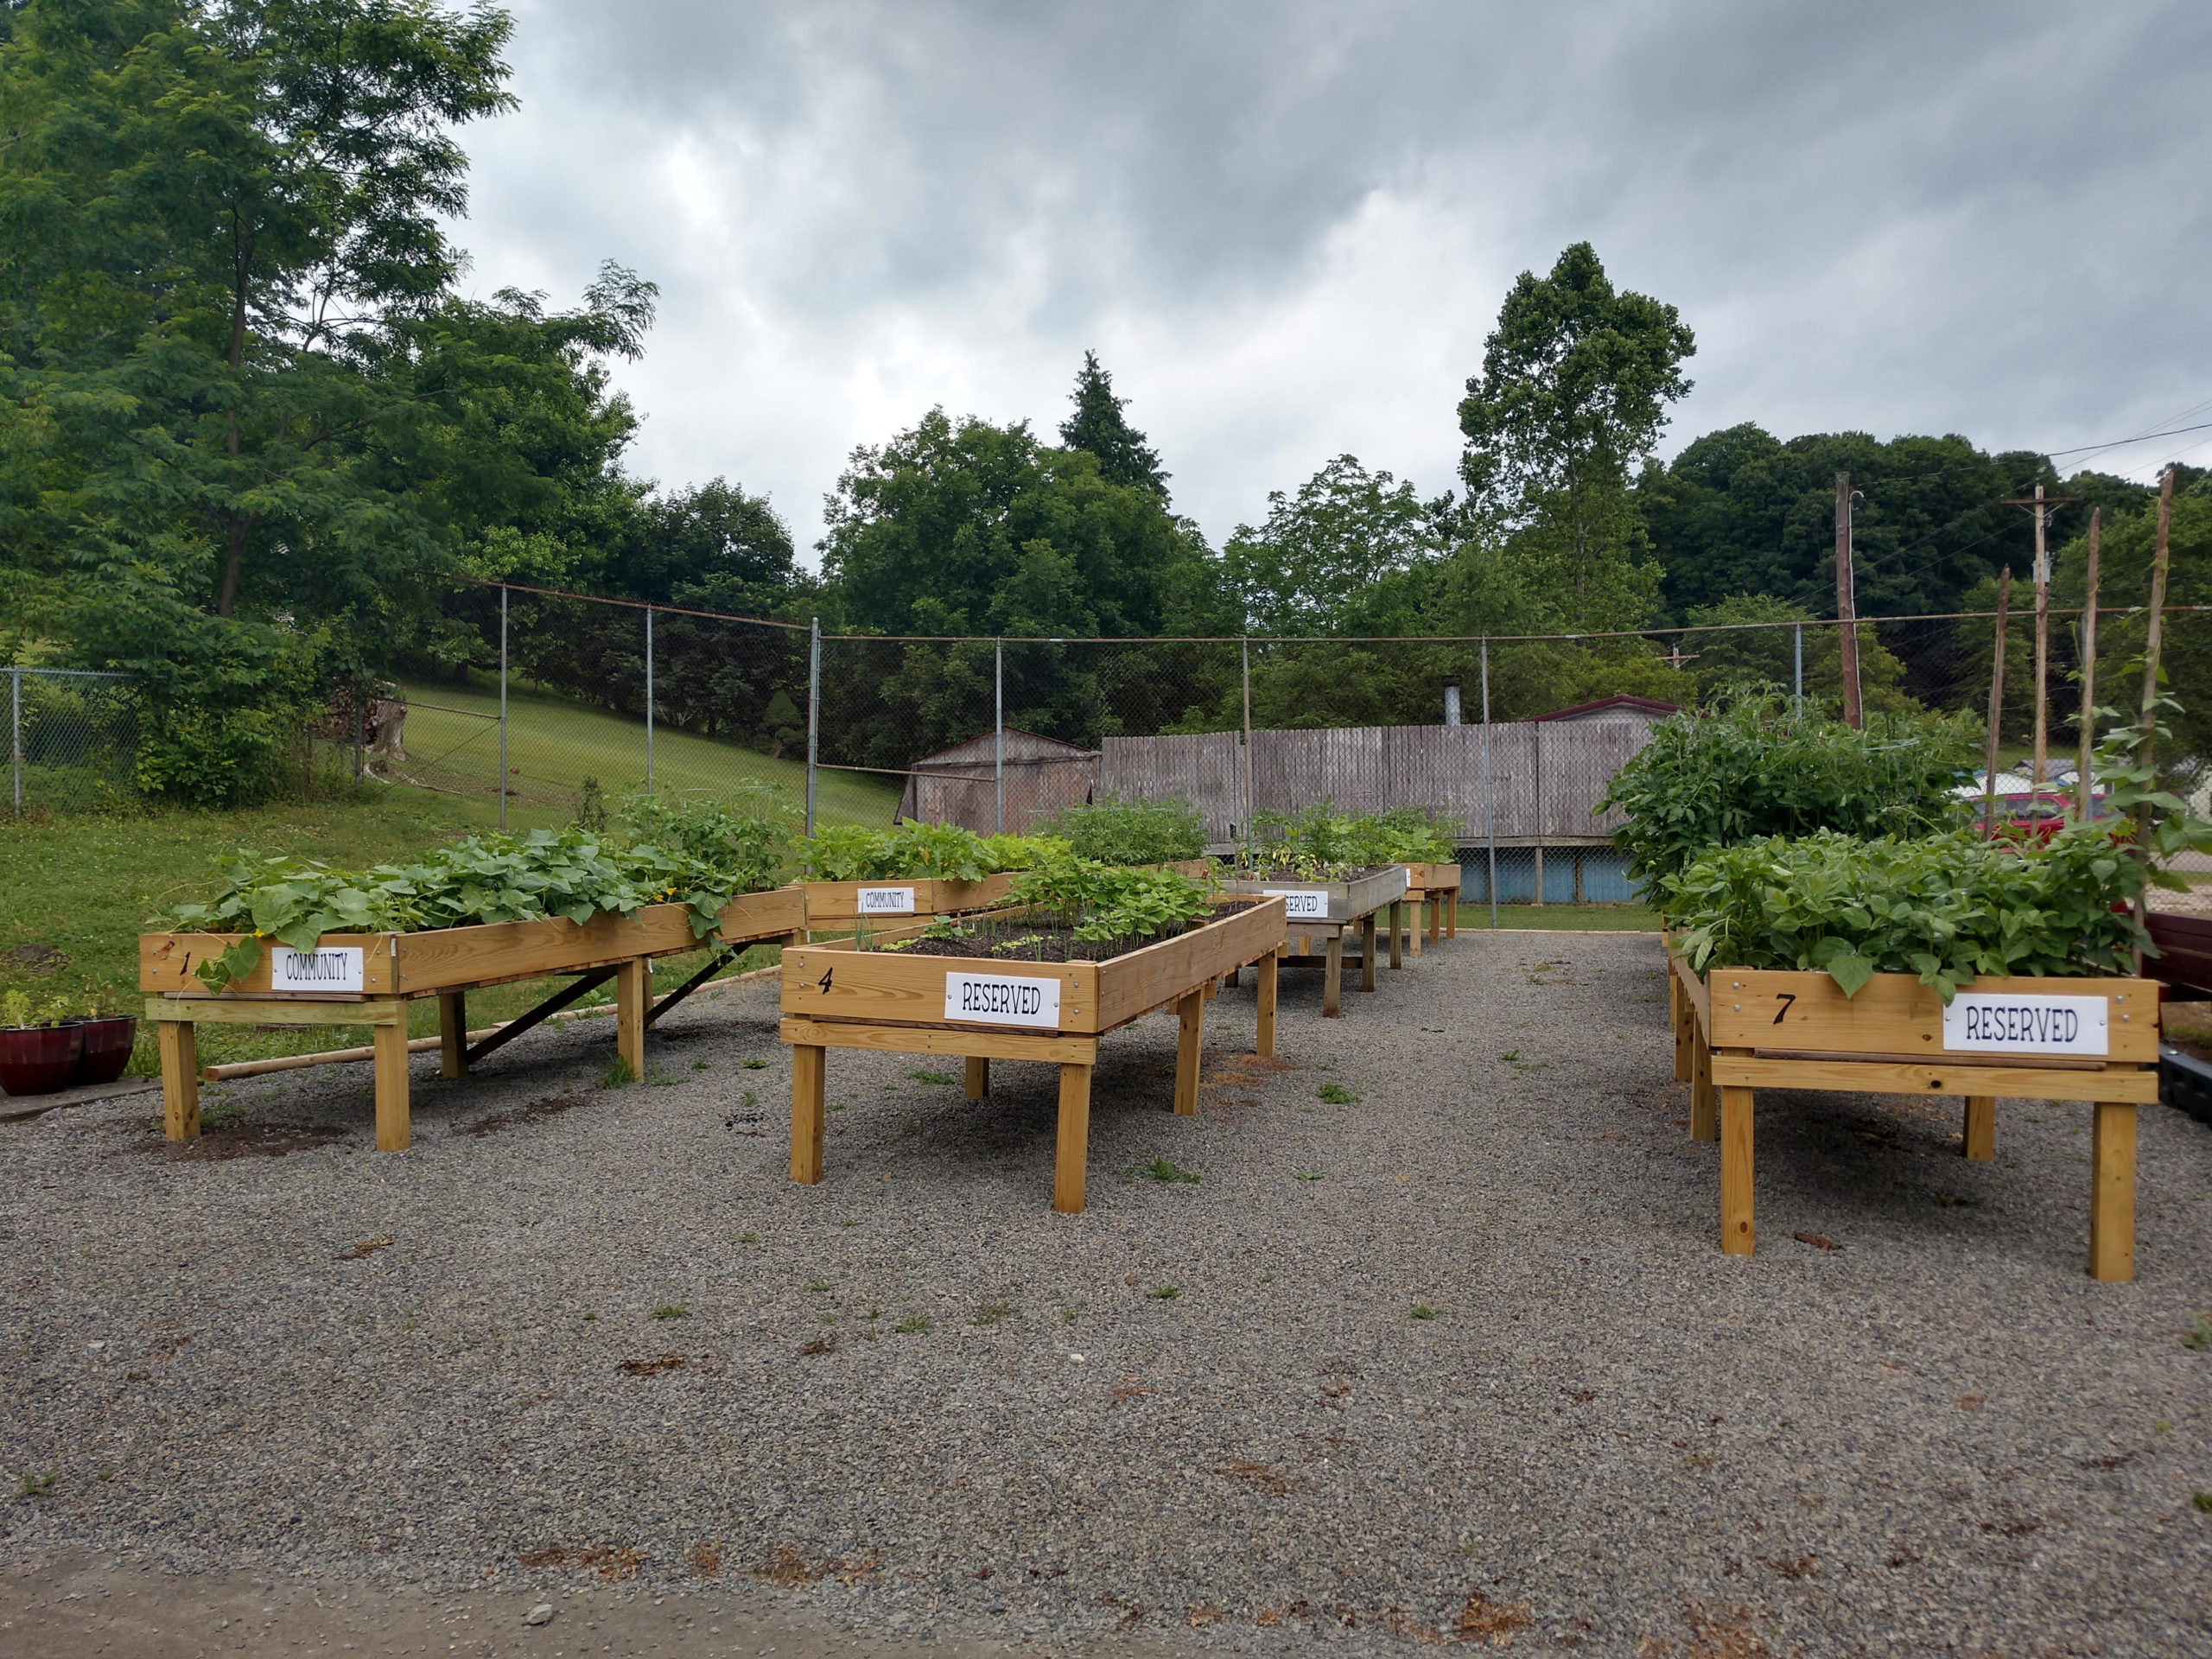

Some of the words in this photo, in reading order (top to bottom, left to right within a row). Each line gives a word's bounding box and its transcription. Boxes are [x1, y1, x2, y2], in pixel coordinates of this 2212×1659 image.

[866, 891, 905, 908] COMMUNITY
[1286, 895, 1318, 912] SERVED
[286, 952, 347, 981] COMMUNITY
[817, 967, 833, 995] 4
[962, 982, 1041, 1015] RESERVED
[1772, 993, 1796, 1025] 7
[1966, 1005, 2078, 1043] RESERVED
